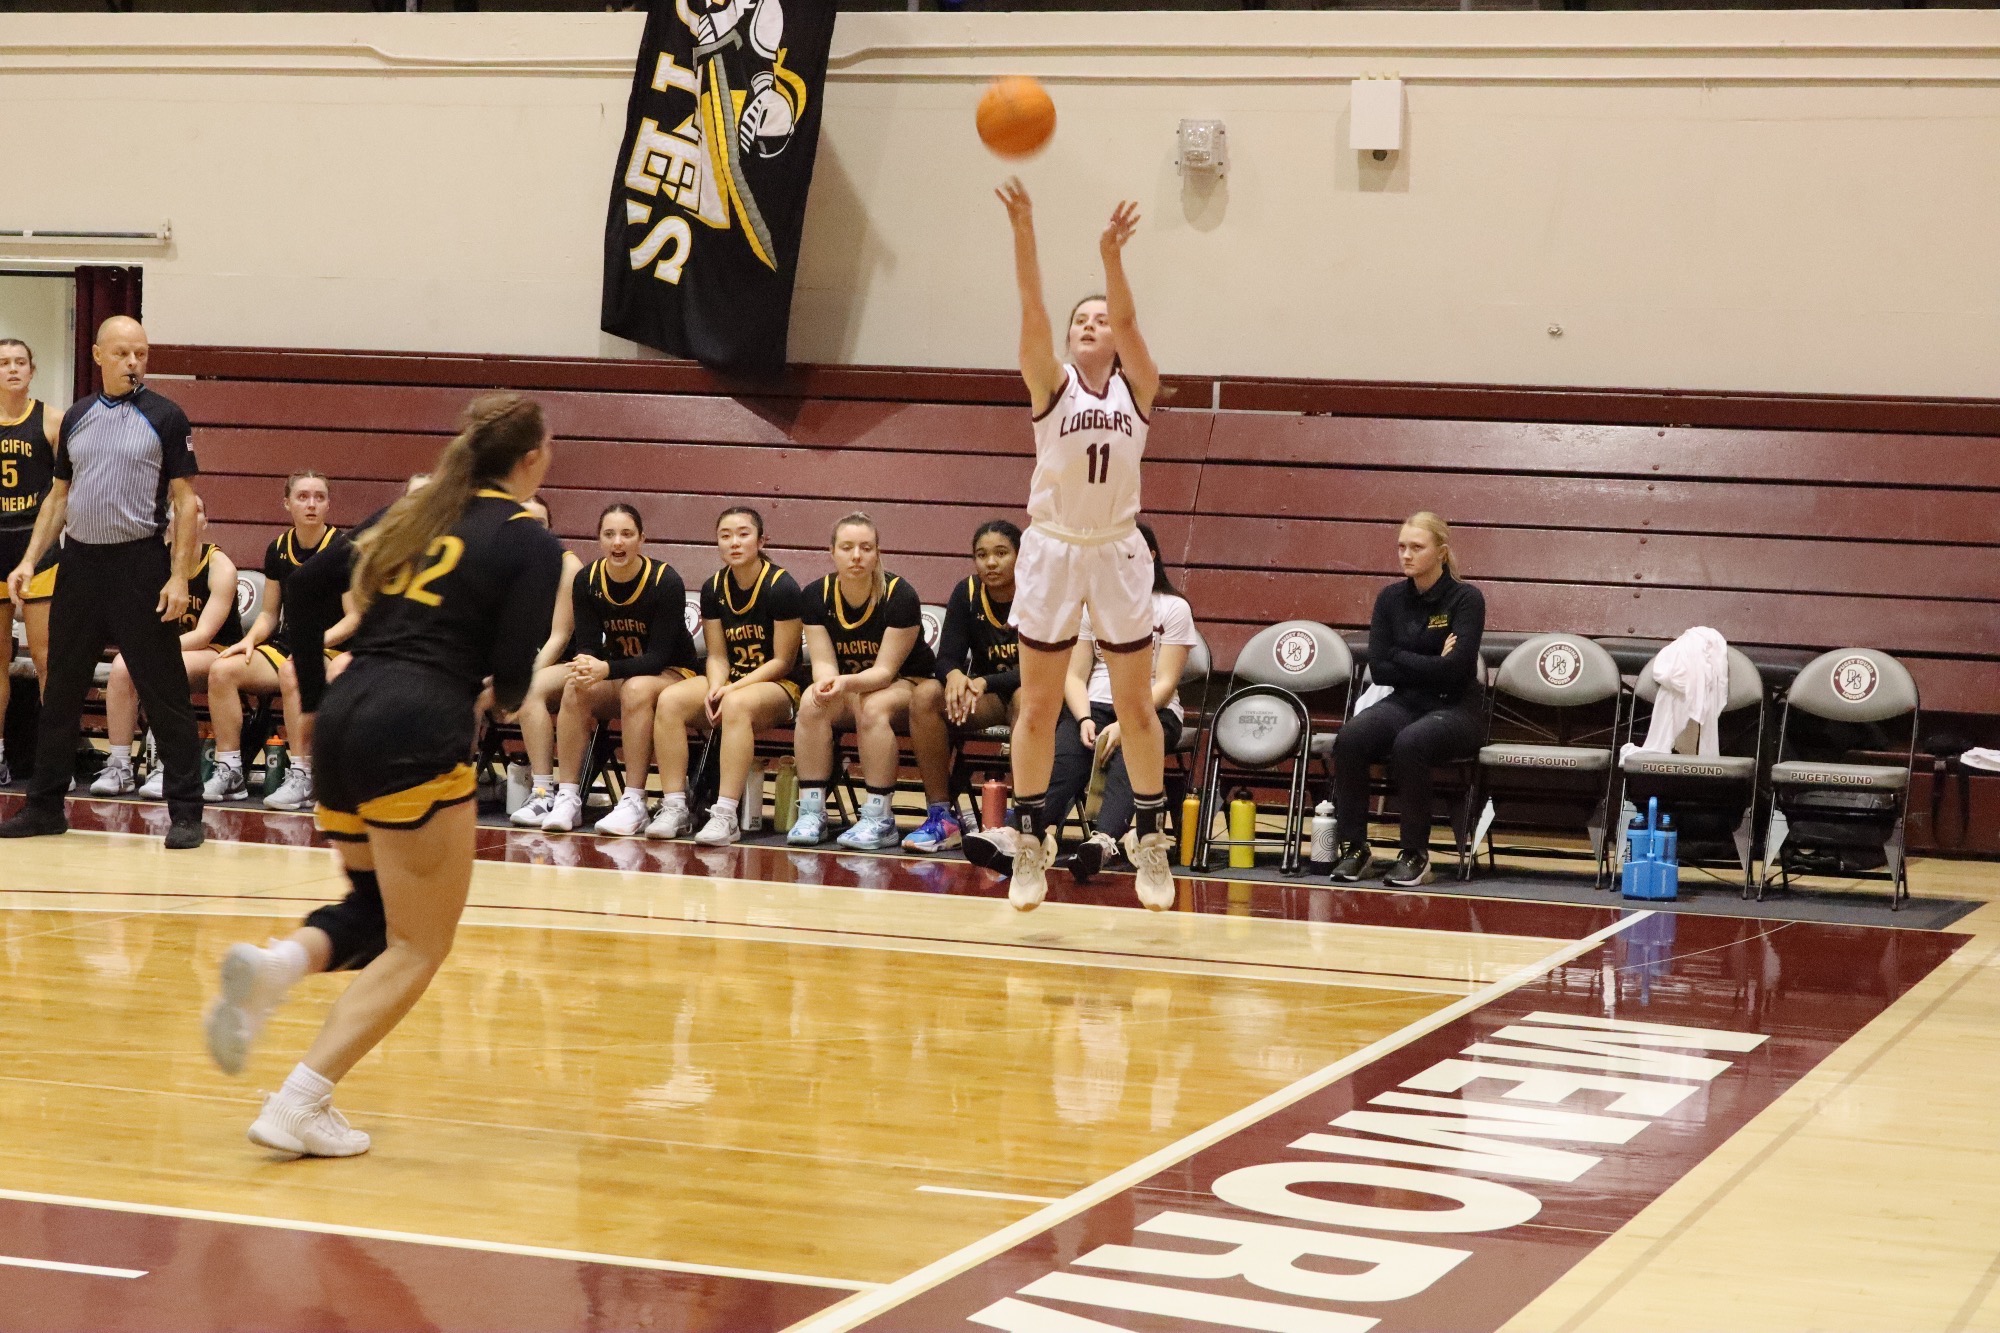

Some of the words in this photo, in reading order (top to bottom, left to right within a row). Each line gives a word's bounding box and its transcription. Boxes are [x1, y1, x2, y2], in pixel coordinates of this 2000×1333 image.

[1060, 408, 1132, 438] LOGGERS
[1, 439, 32, 458] CIFIC
[1086, 443, 1110, 484] 11
[2, 460, 18, 488] 5
[0, 492, 39, 512] HERA
[603, 618, 647, 635] PACIFIC
[725, 624, 765, 641] PACIFIC
[616, 636, 644, 657] 10
[836, 640, 880, 655] PACIFIC
[1280, 632, 1297, 645] PUGET
[1297, 632, 1313, 646] SOUND
[733, 643, 765, 668] 25
[988, 643, 1019, 660] PACIF
[1543, 646, 1560, 658] PUGET
[1561, 646, 1578, 659] SOUND
[1838, 660, 1855, 672] PUGET
[1857, 660, 1874, 673] SOUND
[267, 754, 278, 768] G
[1498, 754, 1535, 765] PUGET
[1538, 757, 1577, 768] SOUND
[1642, 763, 1680, 774] PUGET
[1683, 766, 1723, 776] SOUND
[1791, 772, 1830, 783] PUGET
[1832, 774, 1873, 785] SOUND
